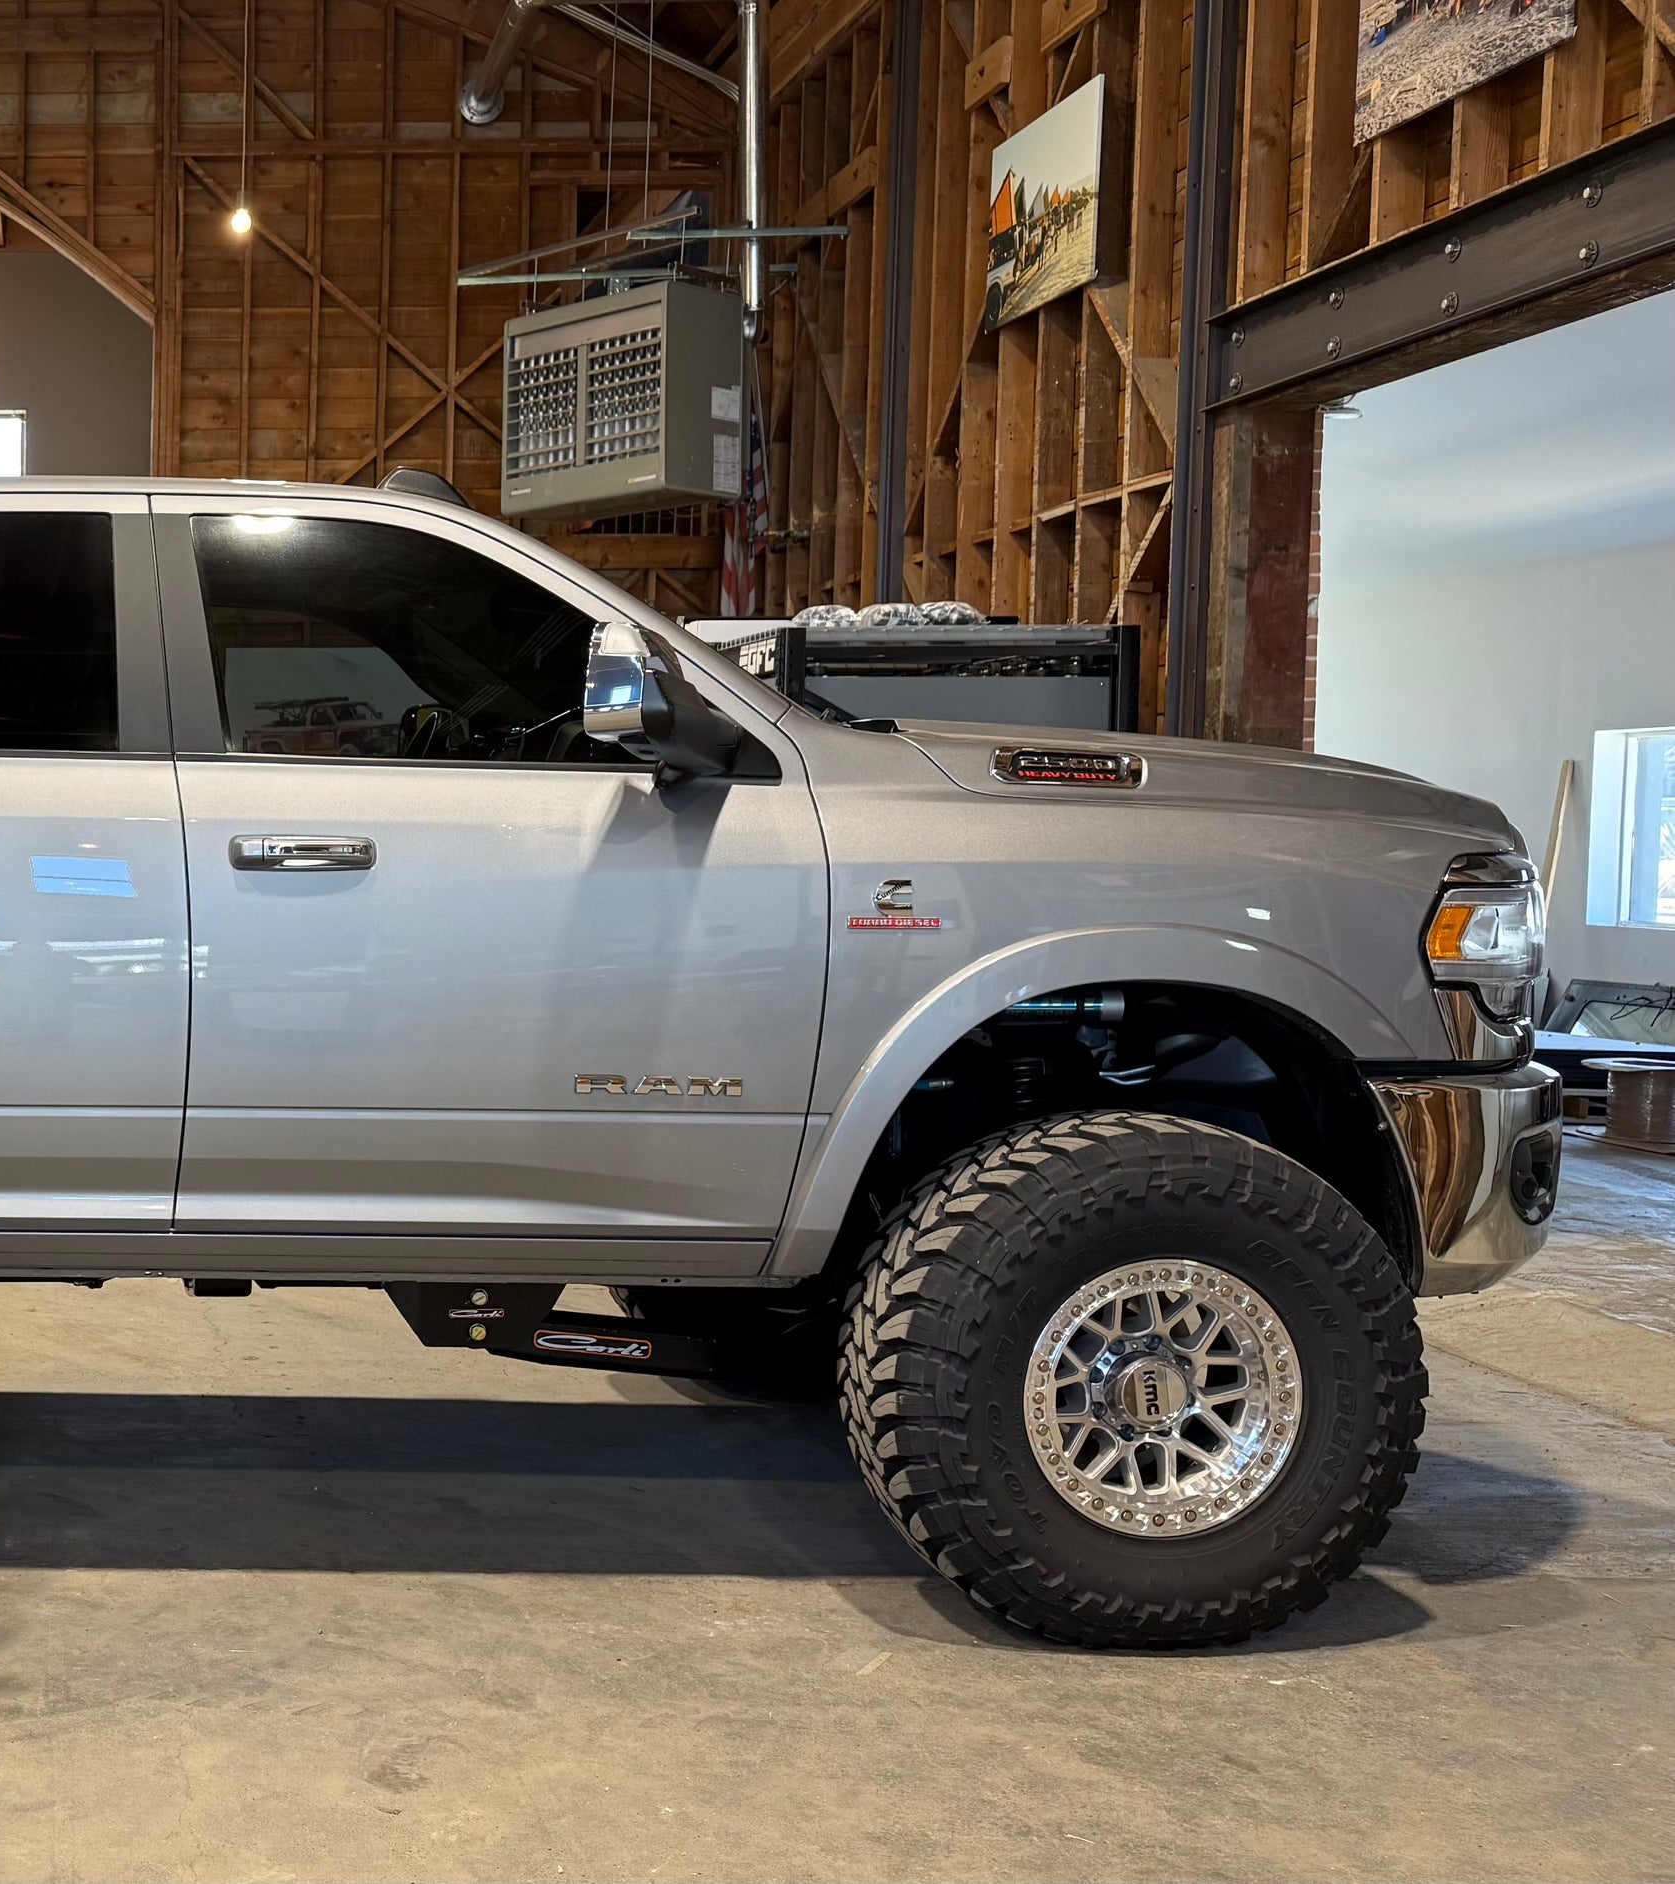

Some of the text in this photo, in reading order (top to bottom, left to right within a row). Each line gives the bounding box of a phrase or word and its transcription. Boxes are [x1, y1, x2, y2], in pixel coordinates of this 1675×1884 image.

[1019, 756, 1117, 770] 2500
[1018, 770, 1116, 780] HEAVY DUTY
[574, 1074, 743, 1097] RAM
[537, 1334, 648, 1357] Carli
[1143, 1370, 1160, 1416] KMC
[1246, 1238, 1359, 1552] OPEN COUNTRY
